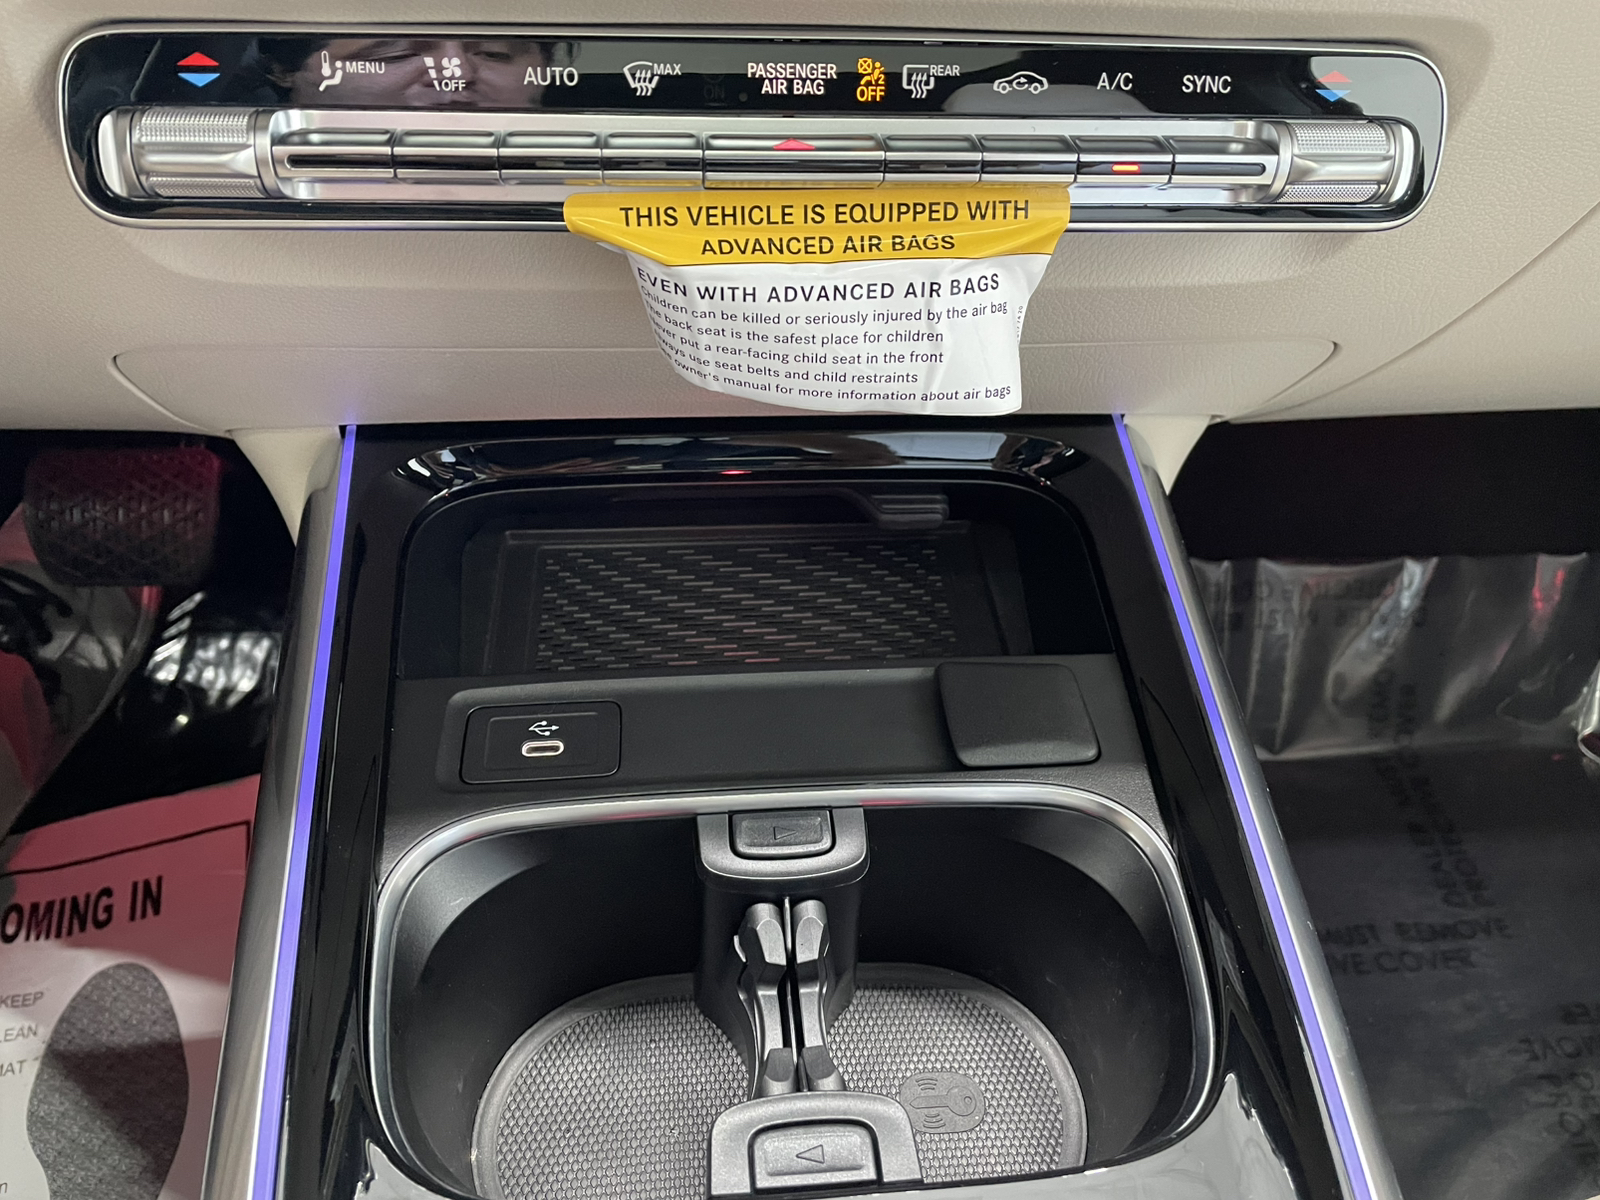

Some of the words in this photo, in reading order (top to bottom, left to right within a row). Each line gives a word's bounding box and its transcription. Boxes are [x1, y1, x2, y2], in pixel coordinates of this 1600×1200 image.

[345, 61, 385, 74] MENU
[523, 66, 579, 86] AUTO
[653, 63, 682, 75] MAX
[747, 62, 837, 79] PASSENGER
[930, 65, 960, 76] REAR
[441, 79, 466, 91] OFF
[761, 79, 788, 95] AIR
[793, 79, 825, 95] BAG
[1097, 72, 1133, 91] A/C
[1182, 75, 1232, 94] SYNC
[856, 86, 885, 102] OFF
[619, 206, 678, 227] THIS
[686, 205, 794, 226] VEHICLE
[803, 204, 825, 224] IS
[834, 201, 959, 224] EQUIPPED
[967, 200, 1029, 221] WITH
[701, 236, 834, 255] ADVANCED
[842, 235, 883, 254] AIR
[891, 234, 956, 252] BAGS
[637, 267, 687, 297] EVEN
[697, 286, 756, 303] WITH
[767, 283, 894, 303] ADVANCED
[904, 282, 941, 298] AIR
[950, 273, 999, 296] BAGS
[641, 285, 688, 314] Children
[691, 310, 716, 319] can
[721, 310, 738, 321] be
[742, 312, 780, 324] killed
[785, 315, 800, 324] or
[805, 311, 868, 325] seriously
[873, 309, 922, 324] injured
[927, 309, 942, 324] by
[946, 306, 968, 319] the
[971, 303, 987, 317] air
[991, 301, 1008, 314] bag
[664, 313, 693, 332] back
[697, 327, 726, 337] seat
[731, 328, 742, 339] is
[747, 331, 769, 342] the
[773, 333, 816, 344] safest
[821, 333, 858, 348] place
[863, 331, 882, 343] for
[886, 330, 944, 342] children
[680, 336, 700, 350] put
[704, 344, 712, 352] a
[716, 347, 789, 364] rear-facing
[794, 353, 827, 364] child
[832, 353, 862, 364] seat
[866, 352, 878, 364] in
[883, 352, 905, 363] the
[910, 351, 944, 363] front
[689, 354, 710, 366] use
[714, 360, 743, 373] seat
[747, 364, 780, 378] belts
[784, 370, 809, 380] and
[814, 371, 847, 383] child
[851, 372, 918, 384] restraints
[674, 359, 719, 382] owner's
[723, 376, 771, 392] manual
[775, 384, 794, 394] for
[798, 388, 833, 398] more
[837, 389, 916, 401] information
[920, 390, 959, 401] about
[963, 388, 981, 400] air
[985, 386, 1011, 399] bags
[1, 886, 113, 944] OMING
[129, 874, 163, 922] IN
[0, 991, 44, 1009] KEEP
[0, 1024, 38, 1043] EAN
